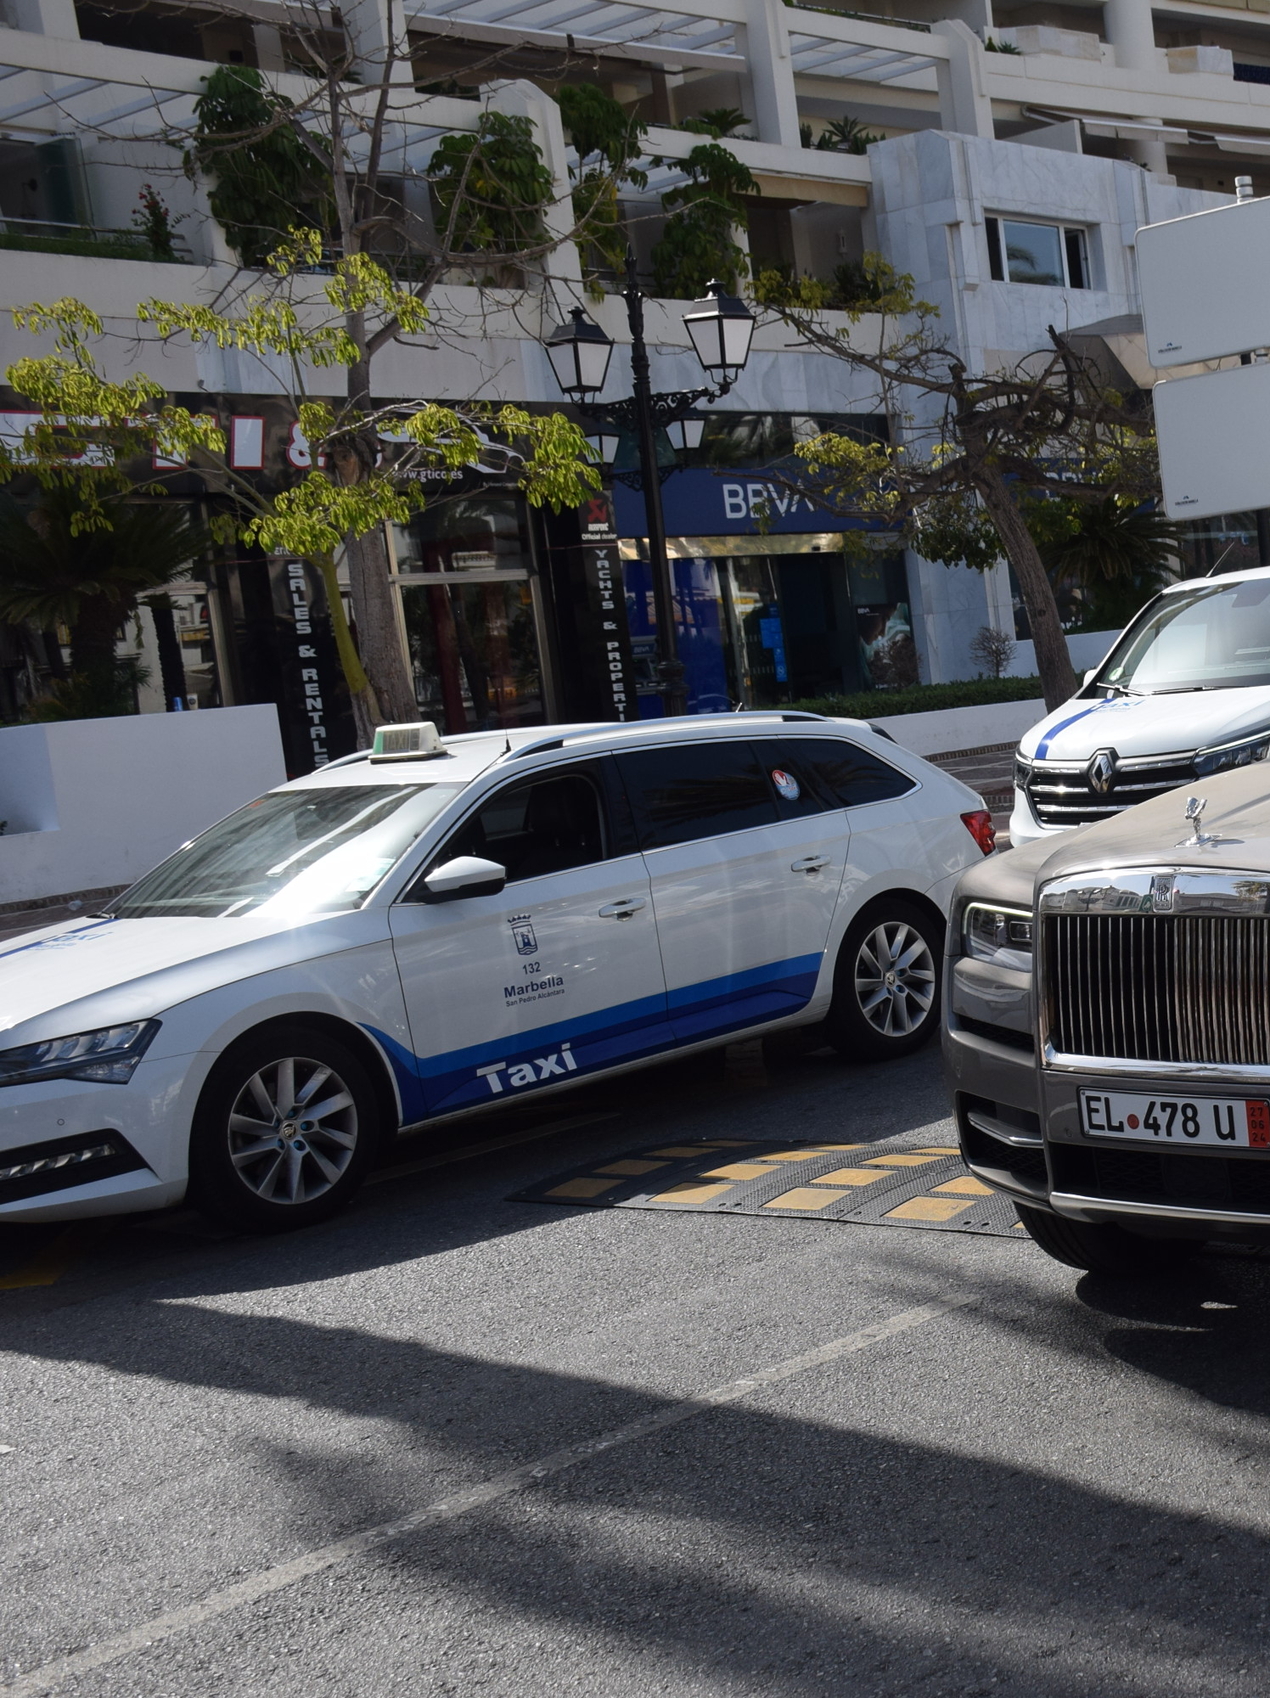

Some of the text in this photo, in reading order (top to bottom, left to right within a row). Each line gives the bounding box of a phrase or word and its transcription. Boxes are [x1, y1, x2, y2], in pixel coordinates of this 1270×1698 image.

[595, 549, 615, 610] YACHTS
[603, 621, 618, 630] &
[287, 564, 330, 767] SALES & RENTALS
[522, 961, 541, 975] 132
[504, 976, 564, 998] Marbella
[519, 995, 537, 1004] Pedro
[476, 1042, 578, 1094] Taxi
[1085, 1095, 1236, 1141] EL 478 U
[1250, 1106, 1264, 1117] 27
[1251, 1120, 1265, 1129] 06
[1252, 1132, 1267, 1142] 24
